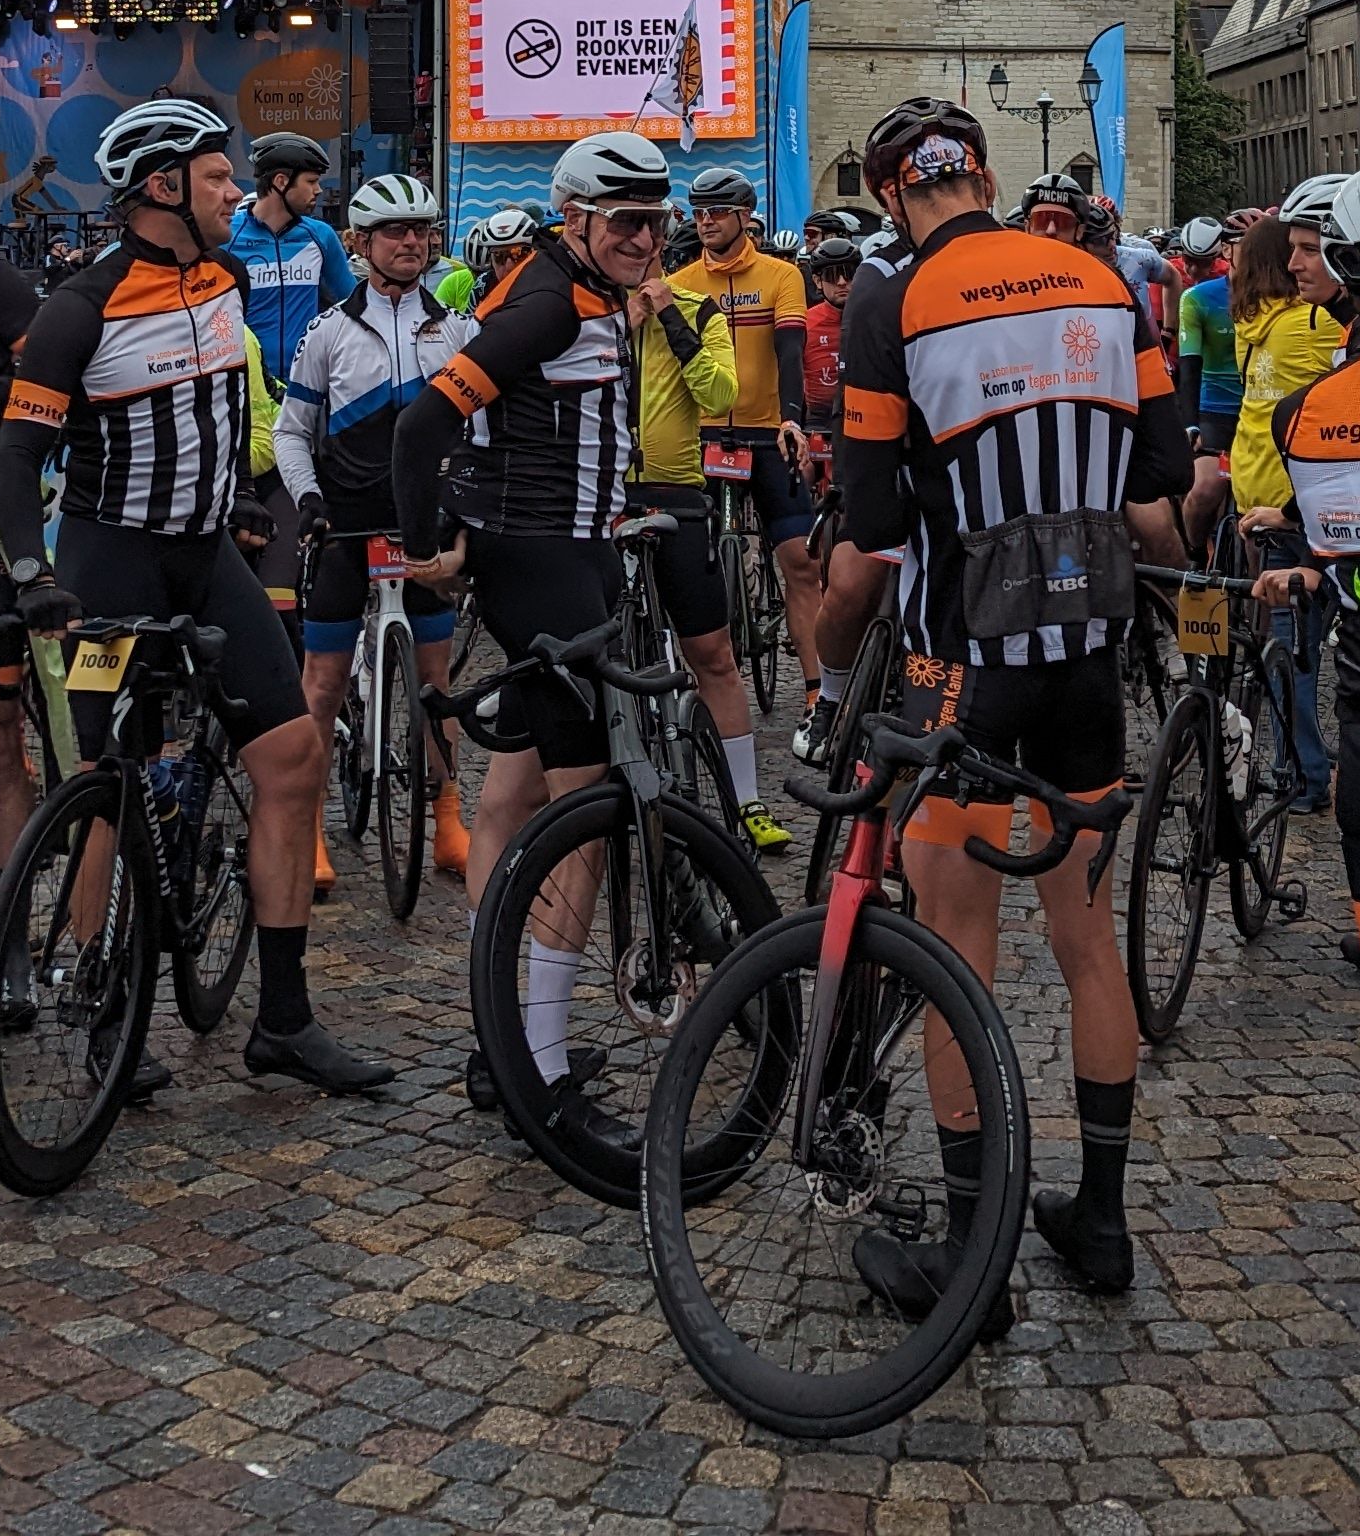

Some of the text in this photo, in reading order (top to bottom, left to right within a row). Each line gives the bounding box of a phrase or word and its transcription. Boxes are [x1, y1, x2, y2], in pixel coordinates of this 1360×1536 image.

[576, 18, 677, 37] DIT IS EEN
[576, 57, 674, 76] EVENEME
[254, 89, 304, 107] Kom op
[259, 107, 301, 125] tegen
[787, 105, 798, 155] KPMG
[1115, 116, 1128, 157] KPMG
[1038, 188, 1069, 204] PNCHR
[256, 264, 313, 285] imelda
[959, 272, 1085, 304] wegkapitein
[148, 362, 173, 375] Kom
[175, 358, 187, 370] op
[981, 382, 1011, 399] Kom
[1011, 378, 1026, 395] op
[1029, 373, 1061, 391] tegen
[721, 456, 737, 468] 42
[1321, 522, 1351, 540] Kom
[1047, 575, 1089, 593] KBC
[1183, 621, 1221, 635] 1000
[79, 653, 121, 670] 1000
[998, 1064, 1016, 1131] PIRELLI
